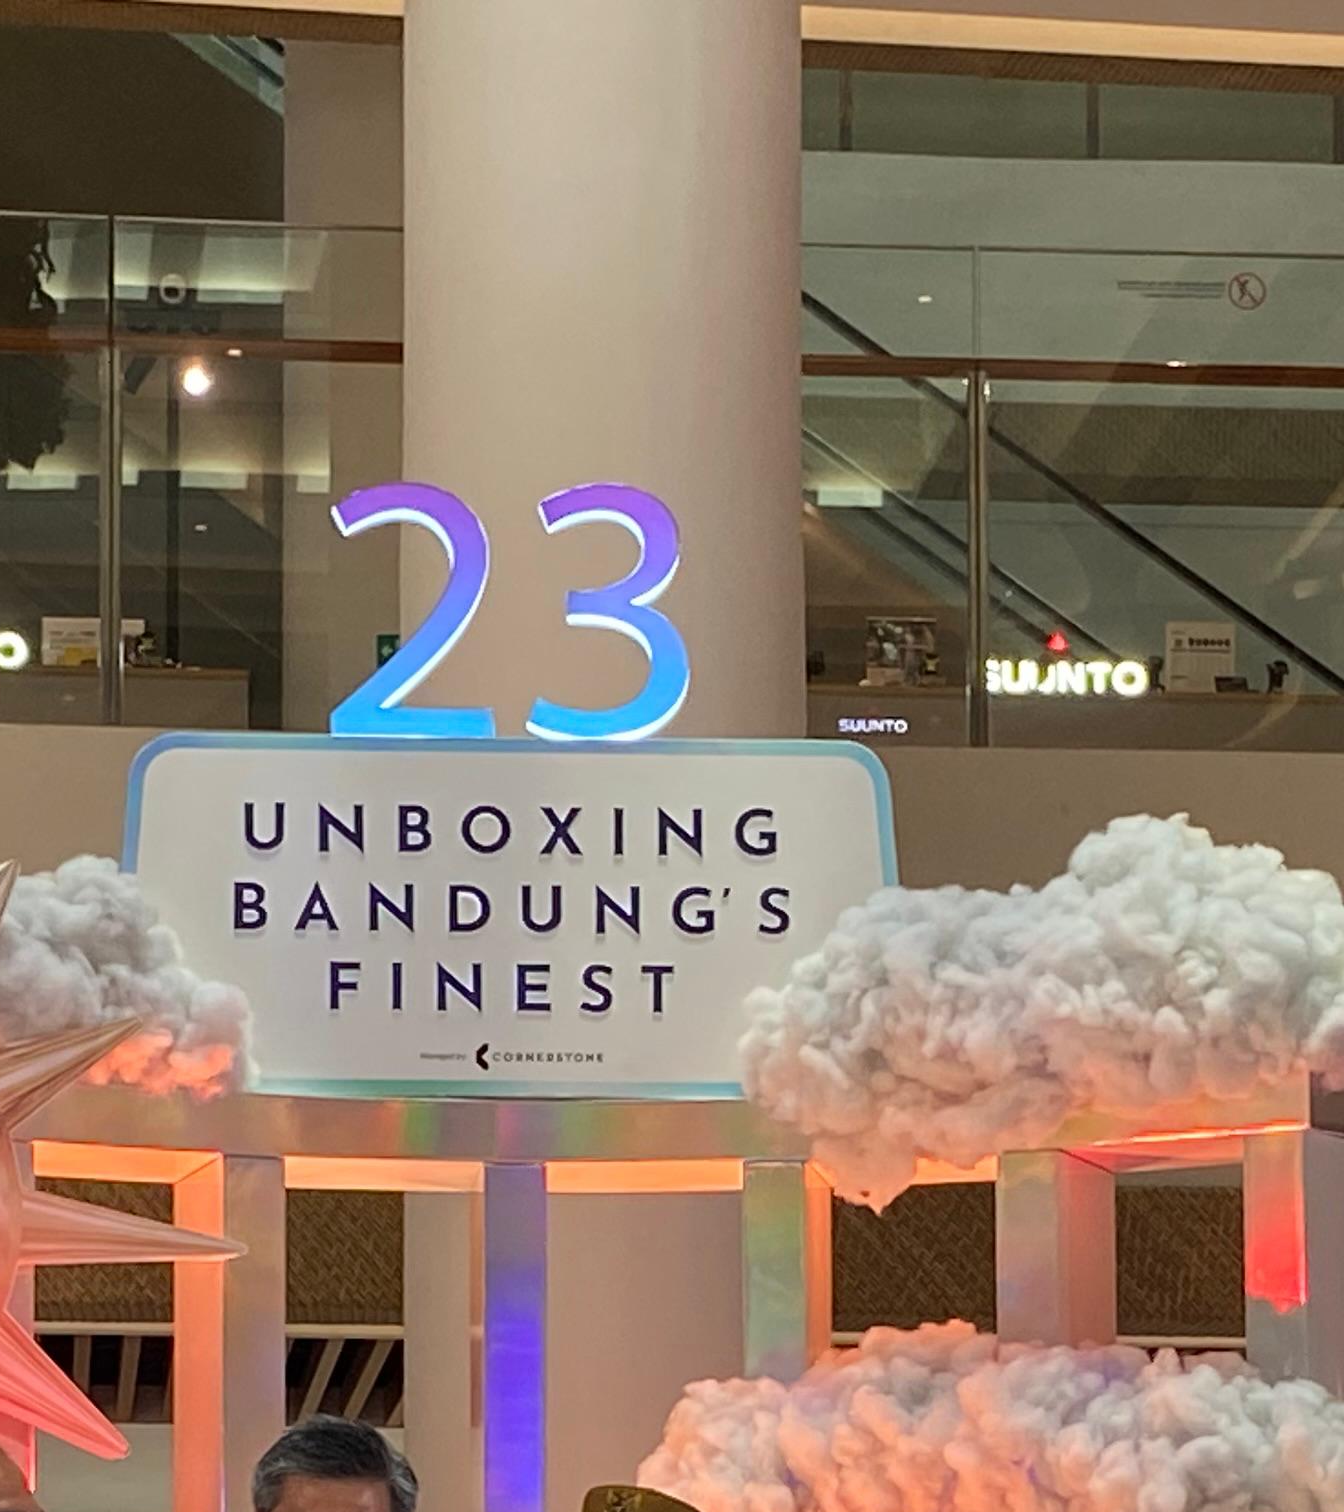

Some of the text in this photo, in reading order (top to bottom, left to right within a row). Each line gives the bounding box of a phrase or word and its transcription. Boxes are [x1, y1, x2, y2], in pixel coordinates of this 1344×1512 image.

[330, 481, 690, 741] 23
[986, 658, 1149, 696] SUUNTO
[838, 718, 908, 733] SUUNTO
[244, 803, 779, 857] UNBOXING
[233, 881, 791, 935] BANDUNG'S
[329, 961, 674, 1013] FINEST
[492, 1052, 604, 1062] CORNERSTONE
